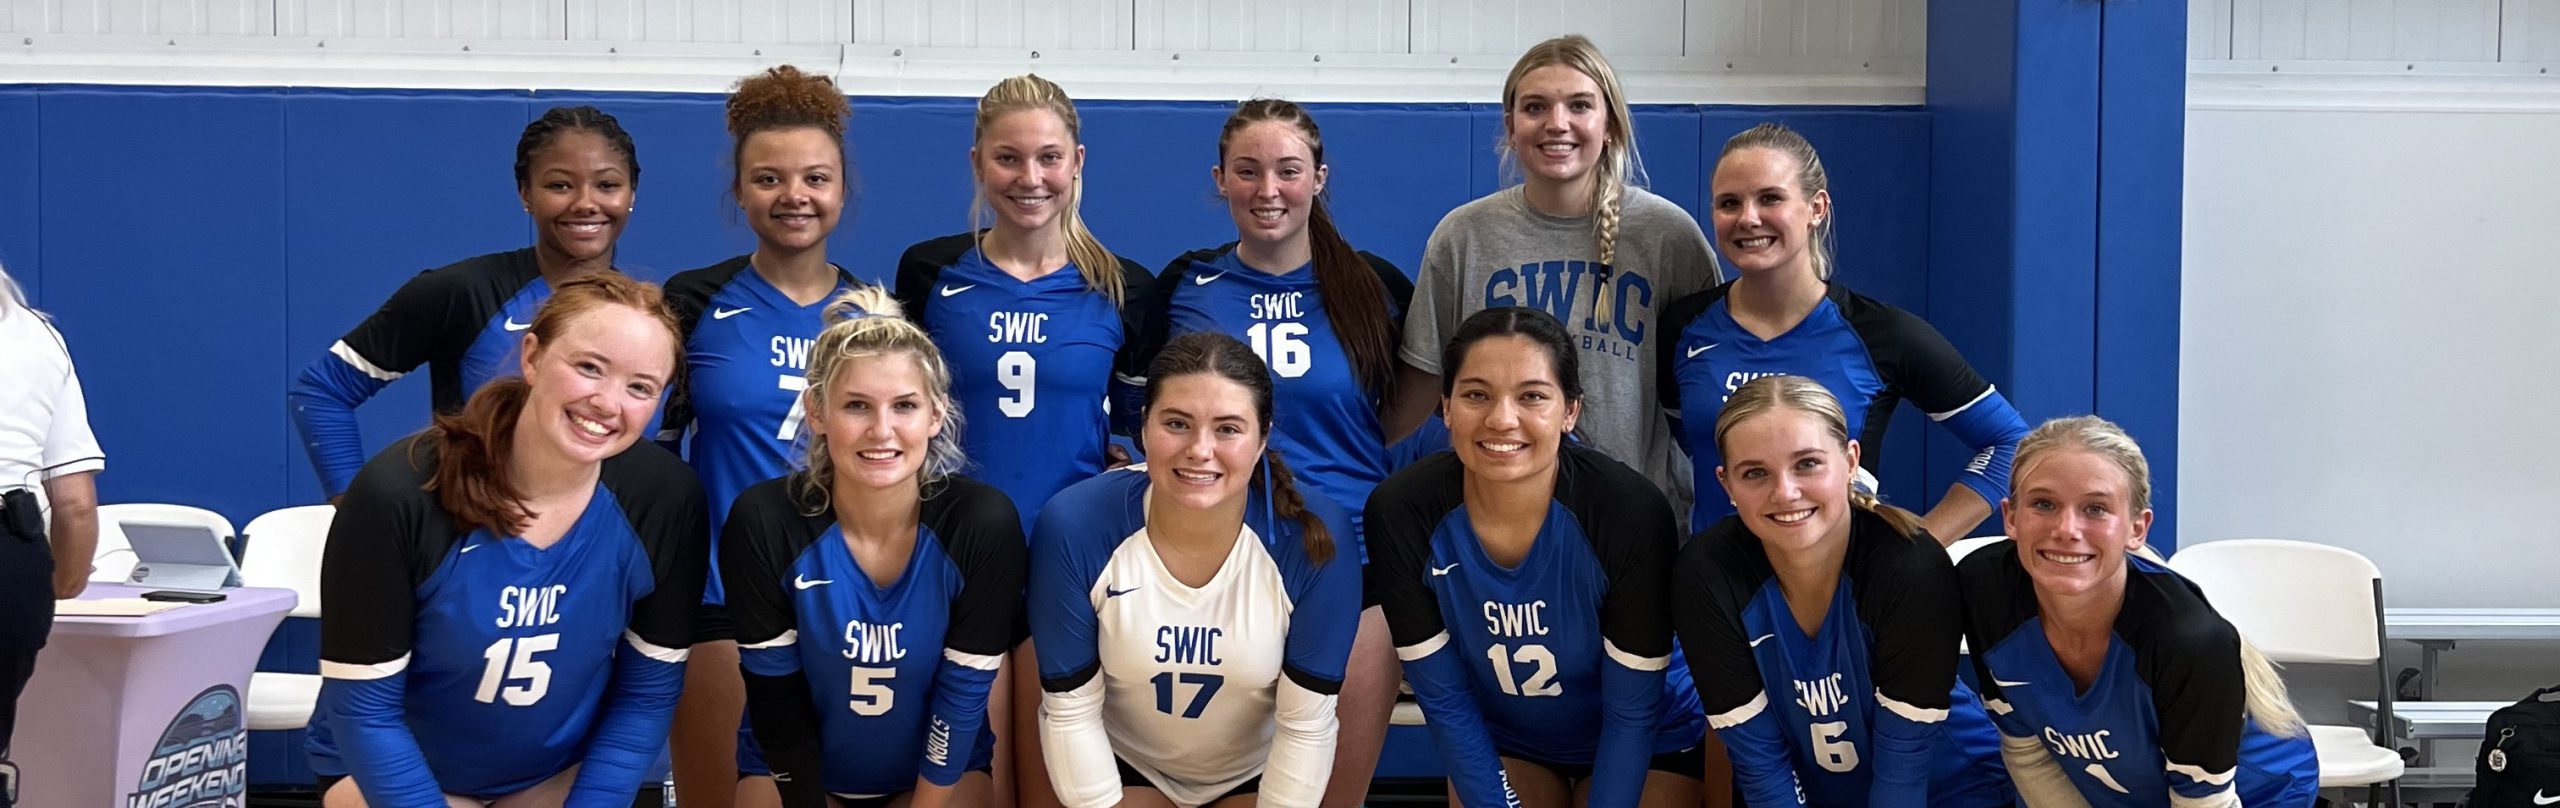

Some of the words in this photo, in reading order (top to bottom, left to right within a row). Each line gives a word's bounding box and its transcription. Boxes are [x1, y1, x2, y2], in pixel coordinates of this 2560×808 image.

[988, 311, 1048, 343] SWIC
[1249, 291, 1304, 319] SWIC
[770, 336, 817, 369] SW
[1246, 322, 1311, 377] 16
[776, 374, 810, 440] 7
[997, 351, 1036, 417] 9
[495, 584, 567, 628] SWIC
[1483, 600, 1549, 637] SWIC
[842, 620, 906, 663] SWIC
[1154, 625, 1223, 665] SWIC
[474, 633, 560, 706] 15
[850, 665, 897, 716] 5
[1487, 643, 1563, 696] 12
[1150, 672, 1225, 719] 17
[138, 730, 247, 791] OPENING
[925, 714, 950, 766] STORM
[1810, 721, 1859, 772] 6
[2044, 726, 2119, 760] SWIC
[2084, 763, 2130, 793] 1
